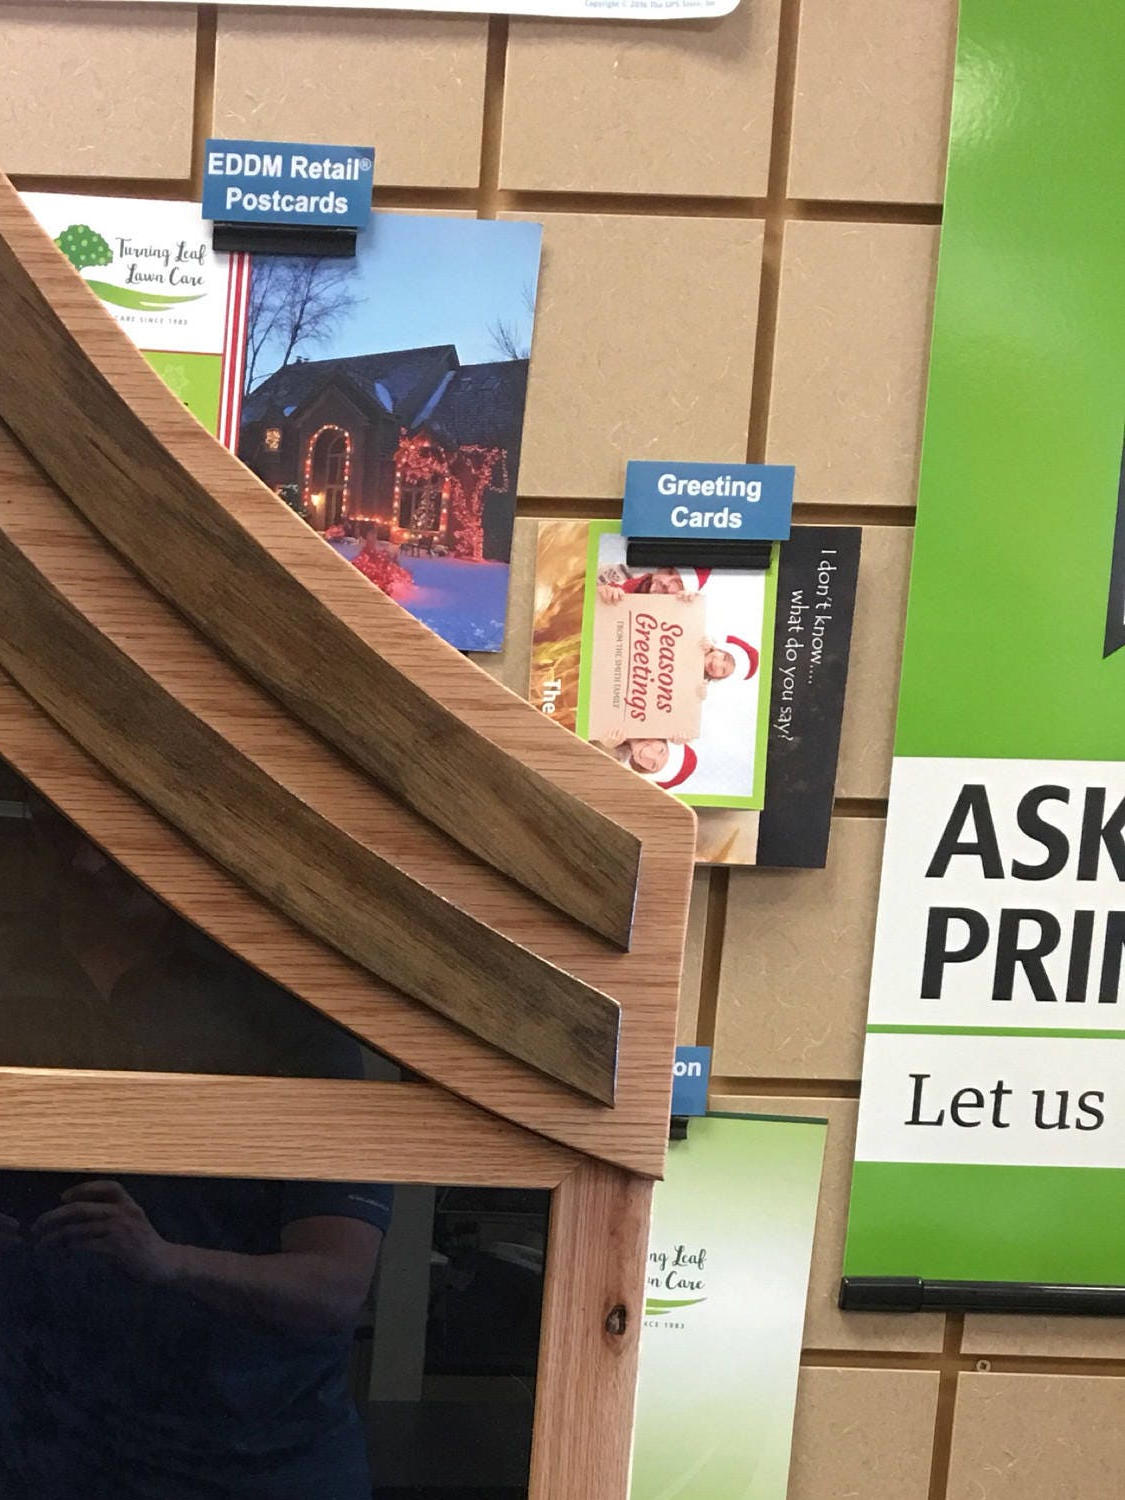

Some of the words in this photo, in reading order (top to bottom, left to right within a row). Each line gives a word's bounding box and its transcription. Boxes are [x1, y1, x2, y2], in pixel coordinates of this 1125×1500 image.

[208, 152, 282, 177] EDDM
[226, 188, 348, 213] Postcards
[115, 237, 171, 267] Turning
[174, 241, 207, 265] Leaf
[125, 263, 166, 284] Lawn
[169, 267, 205, 286] Care
[658, 474, 762, 501] Greeting
[670, 505, 743, 529] Cards
[788, 590, 810, 632] what
[785, 638, 804, 662] do
[624, 613, 658, 722] Greetings
[657, 621, 683, 714] Seasons
[542, 679, 561, 714] The
[779, 666, 796, 701] you
[925, 784, 1125, 882] ASK
[905, 1073, 1012, 1128] Let
[1032, 1088, 1105, 1131] us
[672, 1245, 707, 1270] Leaf
[665, 1270, 705, 1290] Care
